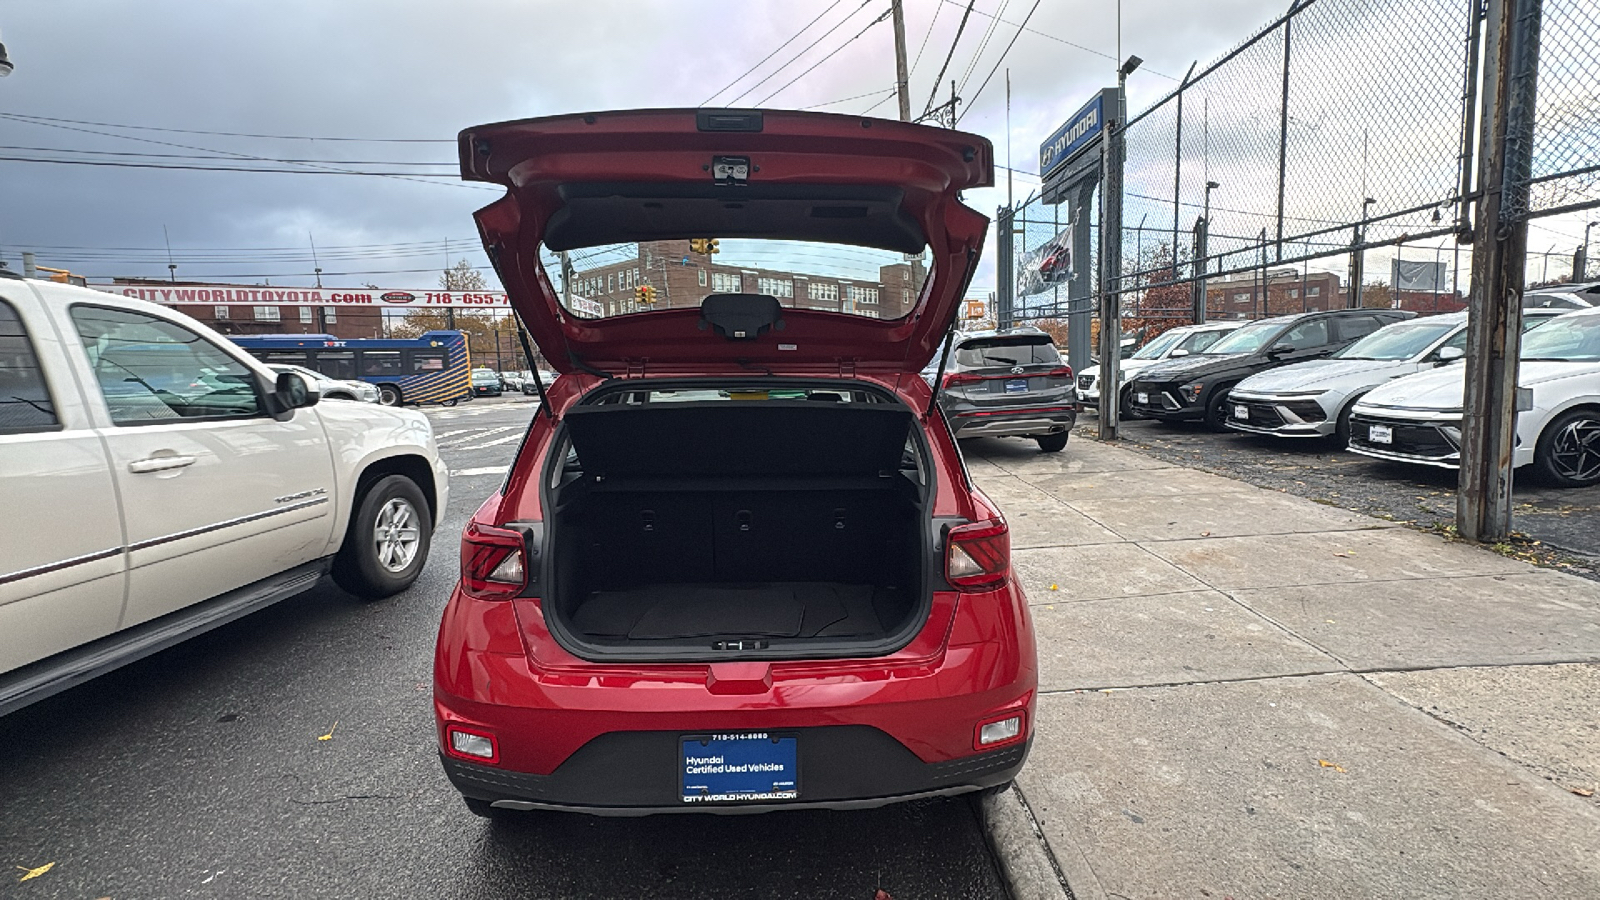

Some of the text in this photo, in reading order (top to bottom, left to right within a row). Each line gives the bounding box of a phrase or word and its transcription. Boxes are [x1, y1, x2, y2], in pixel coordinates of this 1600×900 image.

[1055, 108, 1097, 156] HYUNDAI
[122, 288, 372, 303] CITYWORLDTOYOTA.com
[686, 755, 724, 766] Hyundai
[686, 763, 784, 774] Certified Used Vehicles
